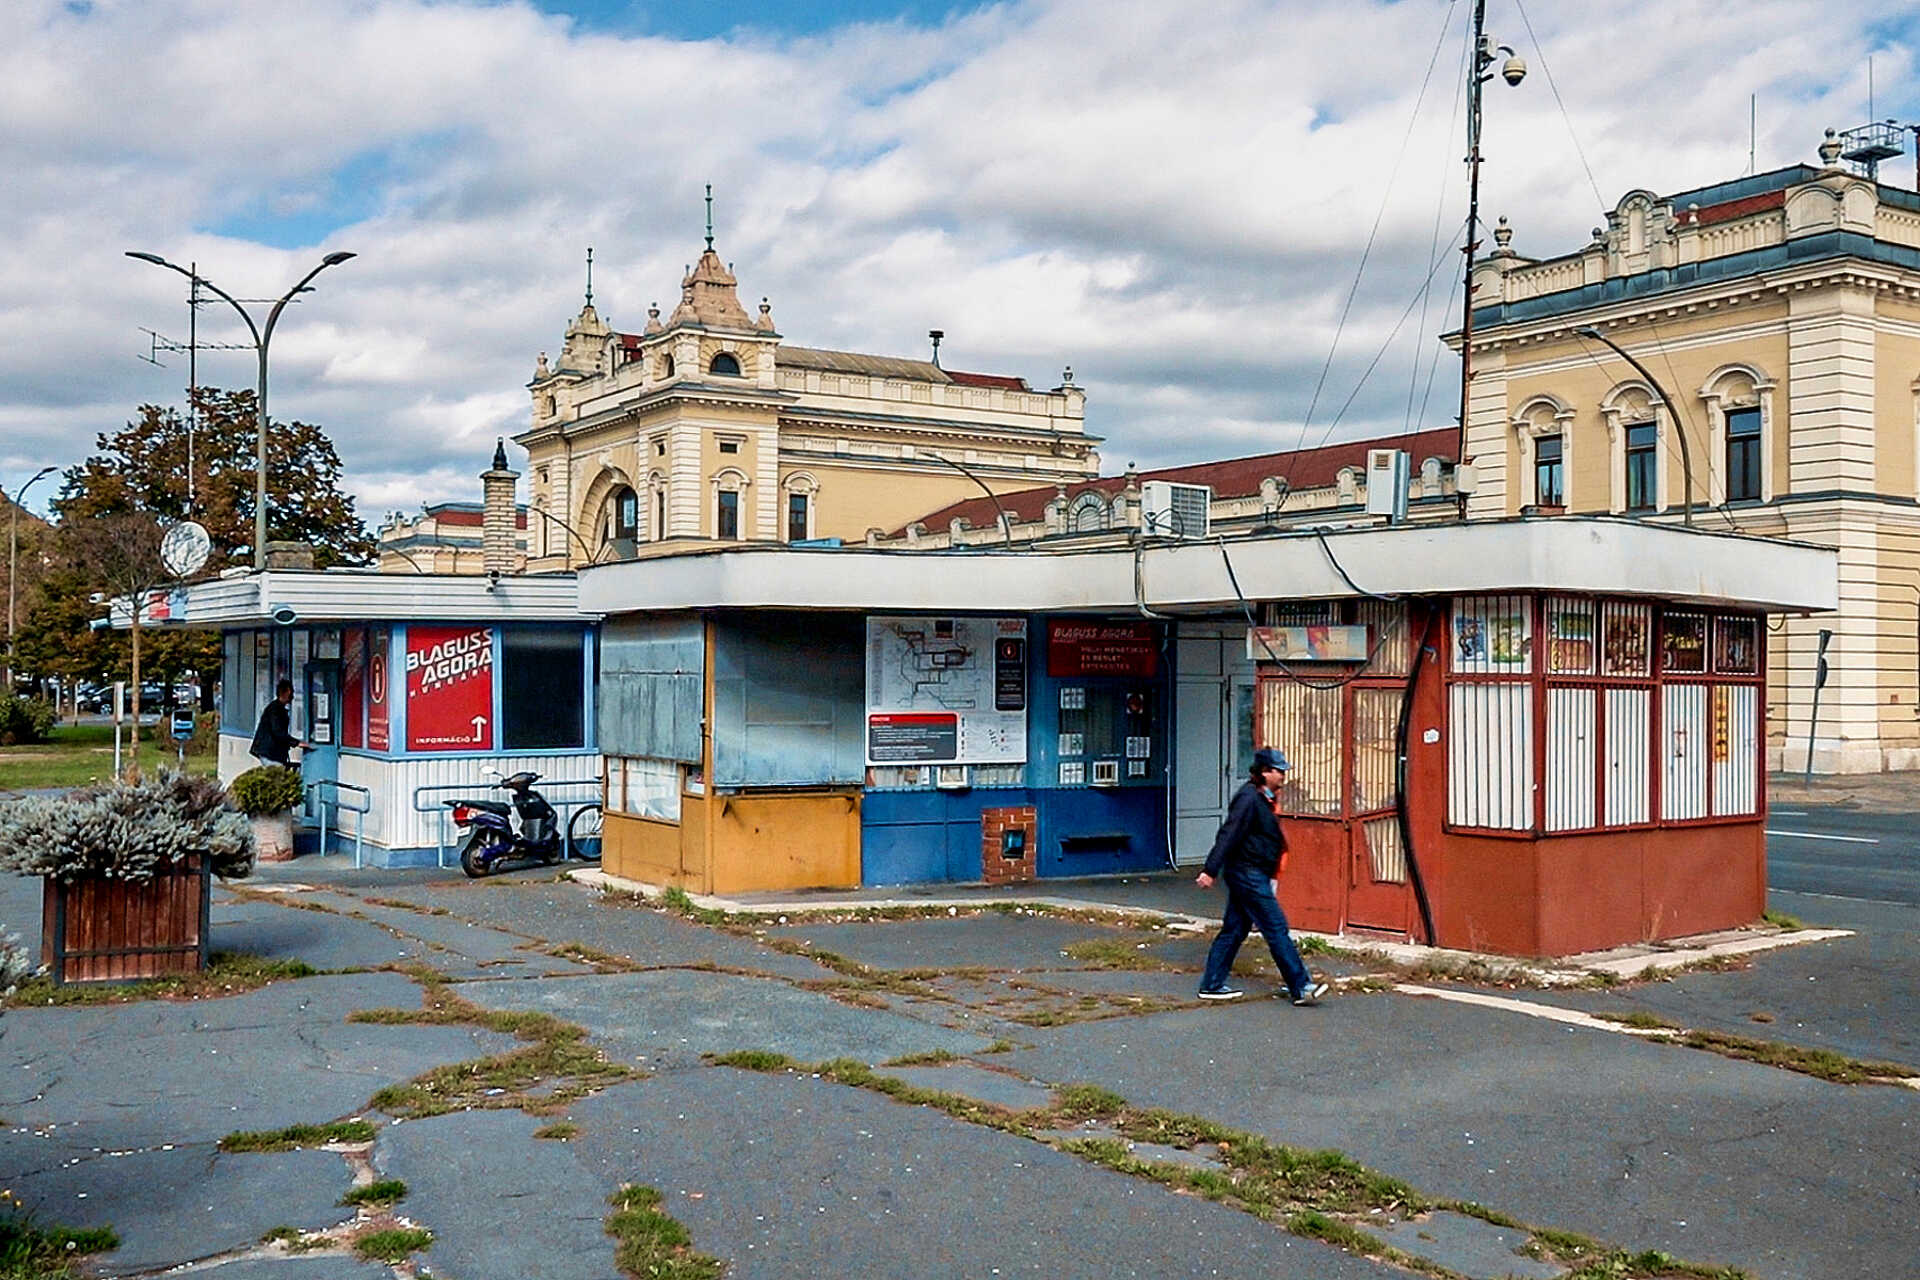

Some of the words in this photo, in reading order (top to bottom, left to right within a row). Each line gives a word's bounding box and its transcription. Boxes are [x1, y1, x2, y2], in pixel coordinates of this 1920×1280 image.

[406, 628, 493, 672] BLAGUSS
[421, 647, 493, 685] AGORA
[415, 735, 471, 744] INFORMÁCIÓ
